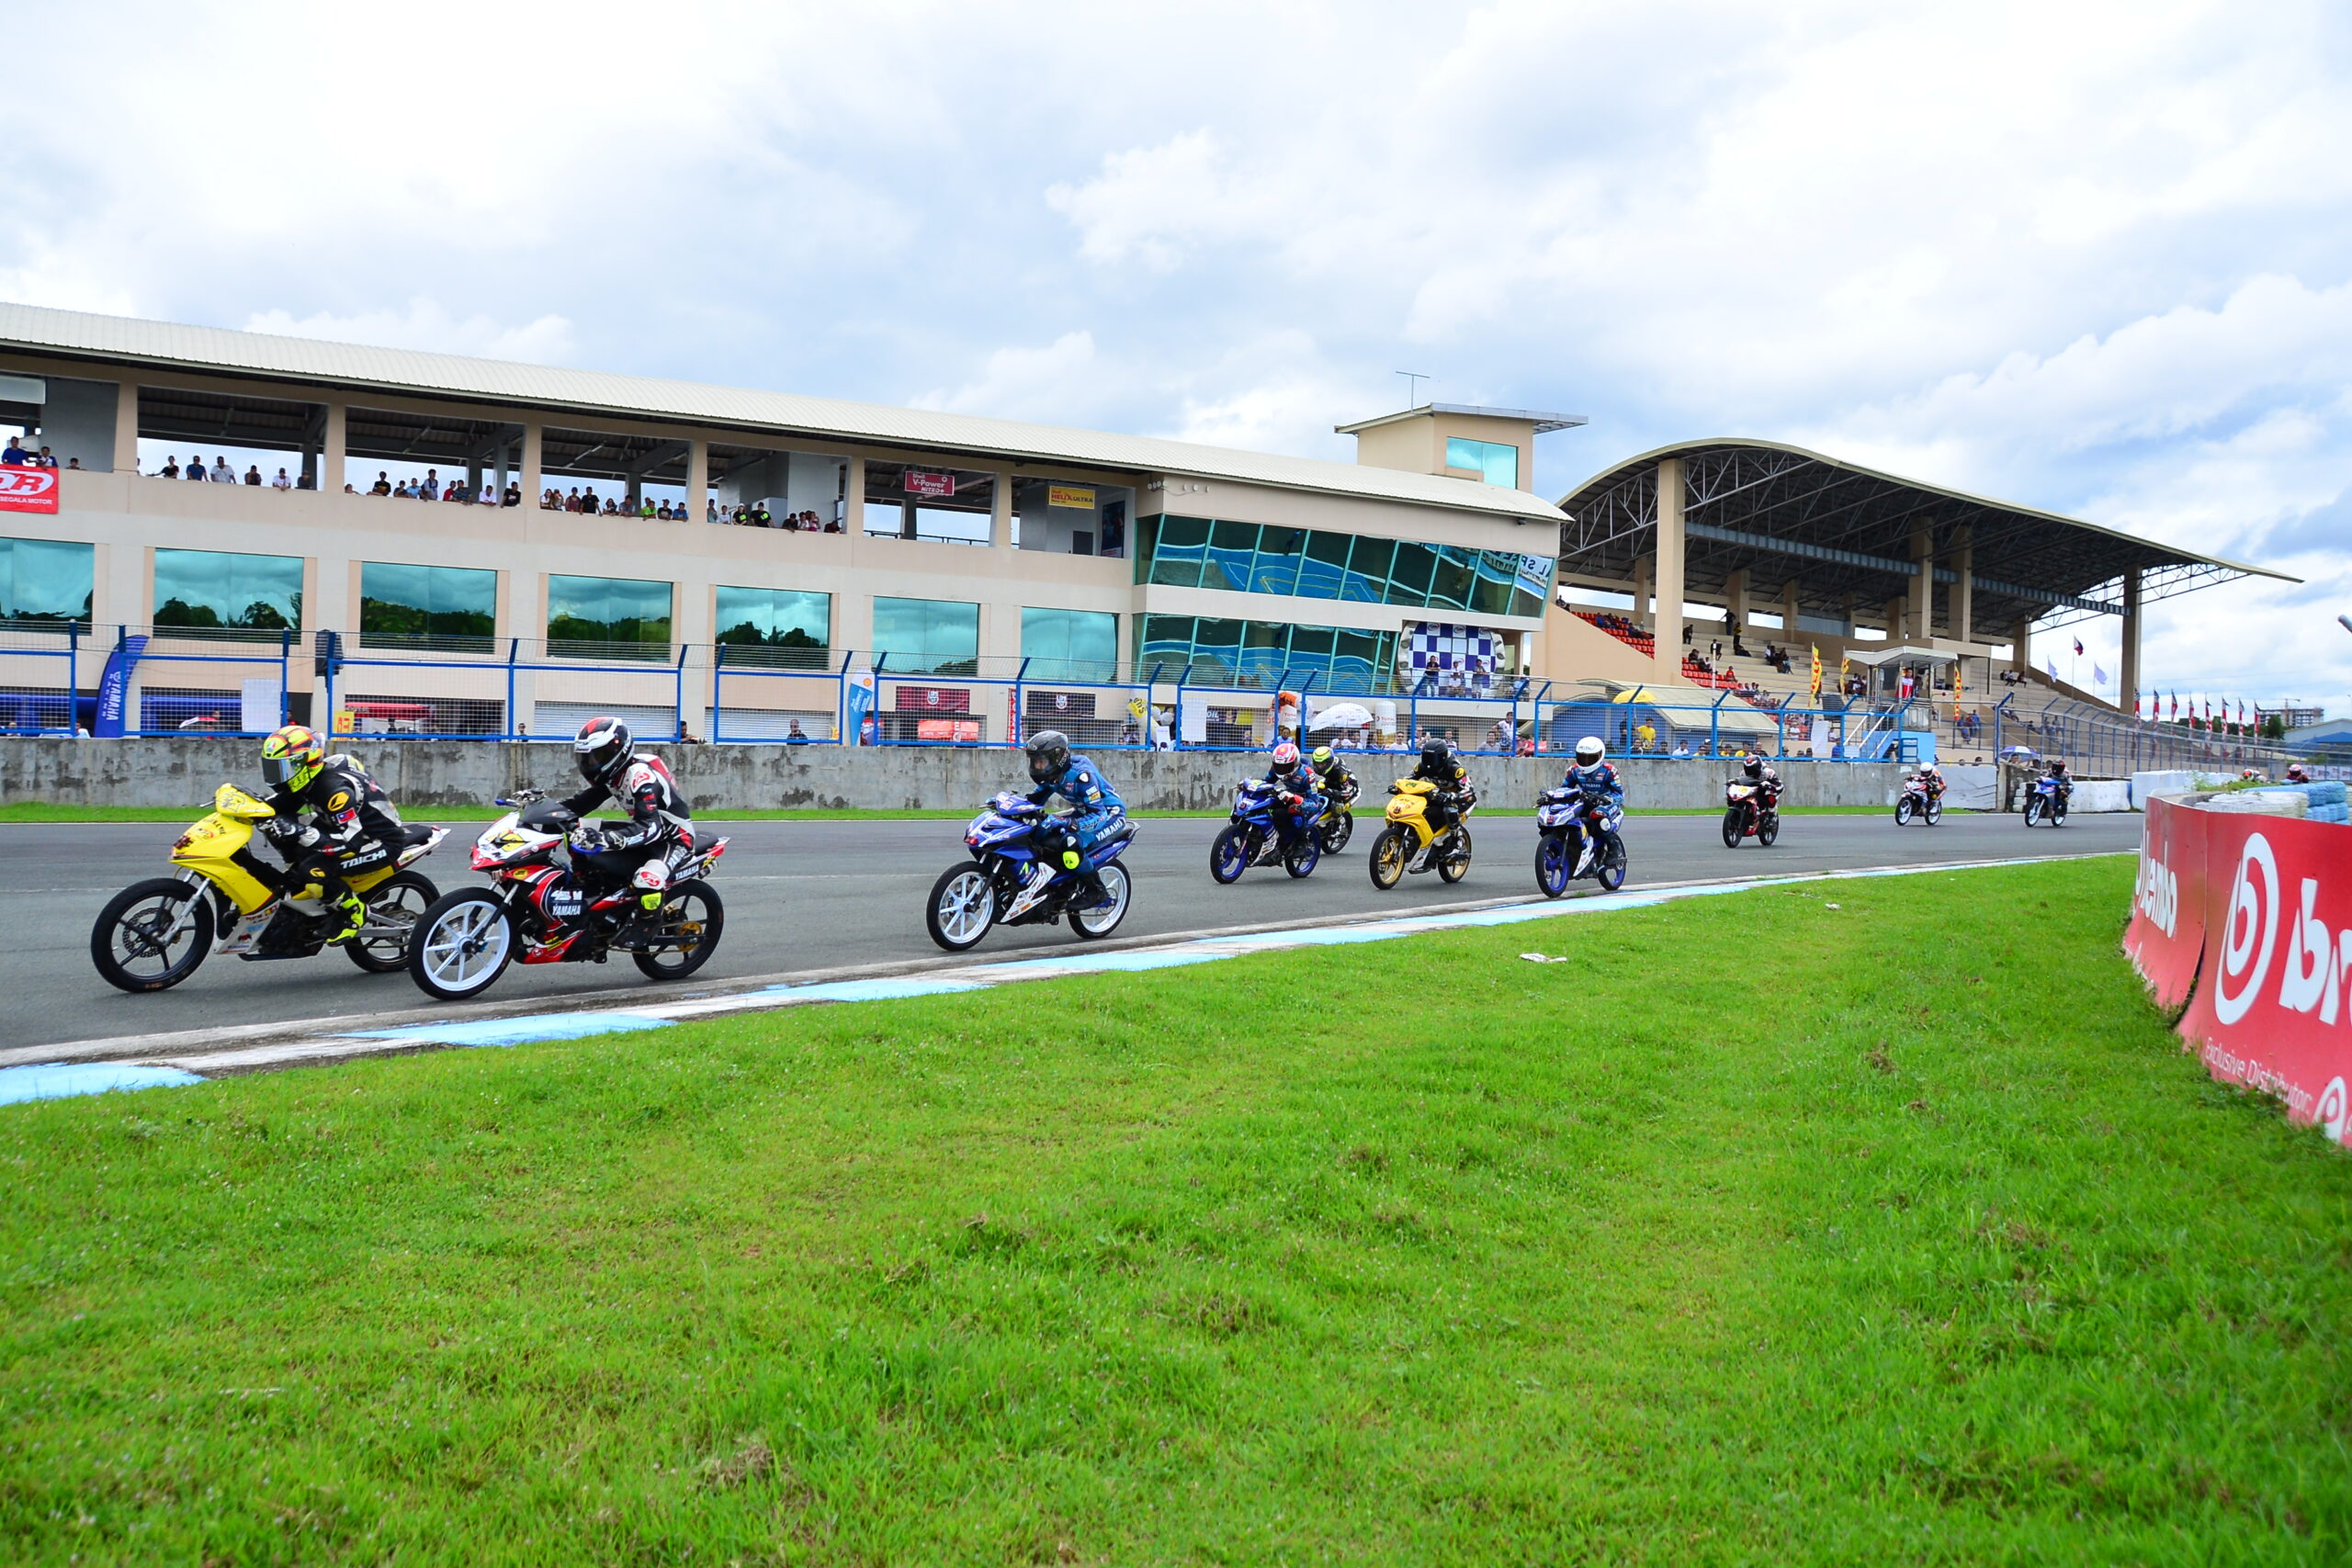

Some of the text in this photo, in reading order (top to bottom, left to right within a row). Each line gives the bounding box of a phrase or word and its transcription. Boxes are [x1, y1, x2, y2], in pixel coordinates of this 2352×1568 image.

[913, 479, 944, 488] V-Power
[1051, 492, 1072, 502] HELIX
[106, 683, 121, 721] YAMAHA
[340, 849, 388, 870] TAICHI
[552, 905, 582, 916] YAMAHA
[2278, 876, 2352, 1027] br
[2205, 1036, 2246, 1079] Exclusive
